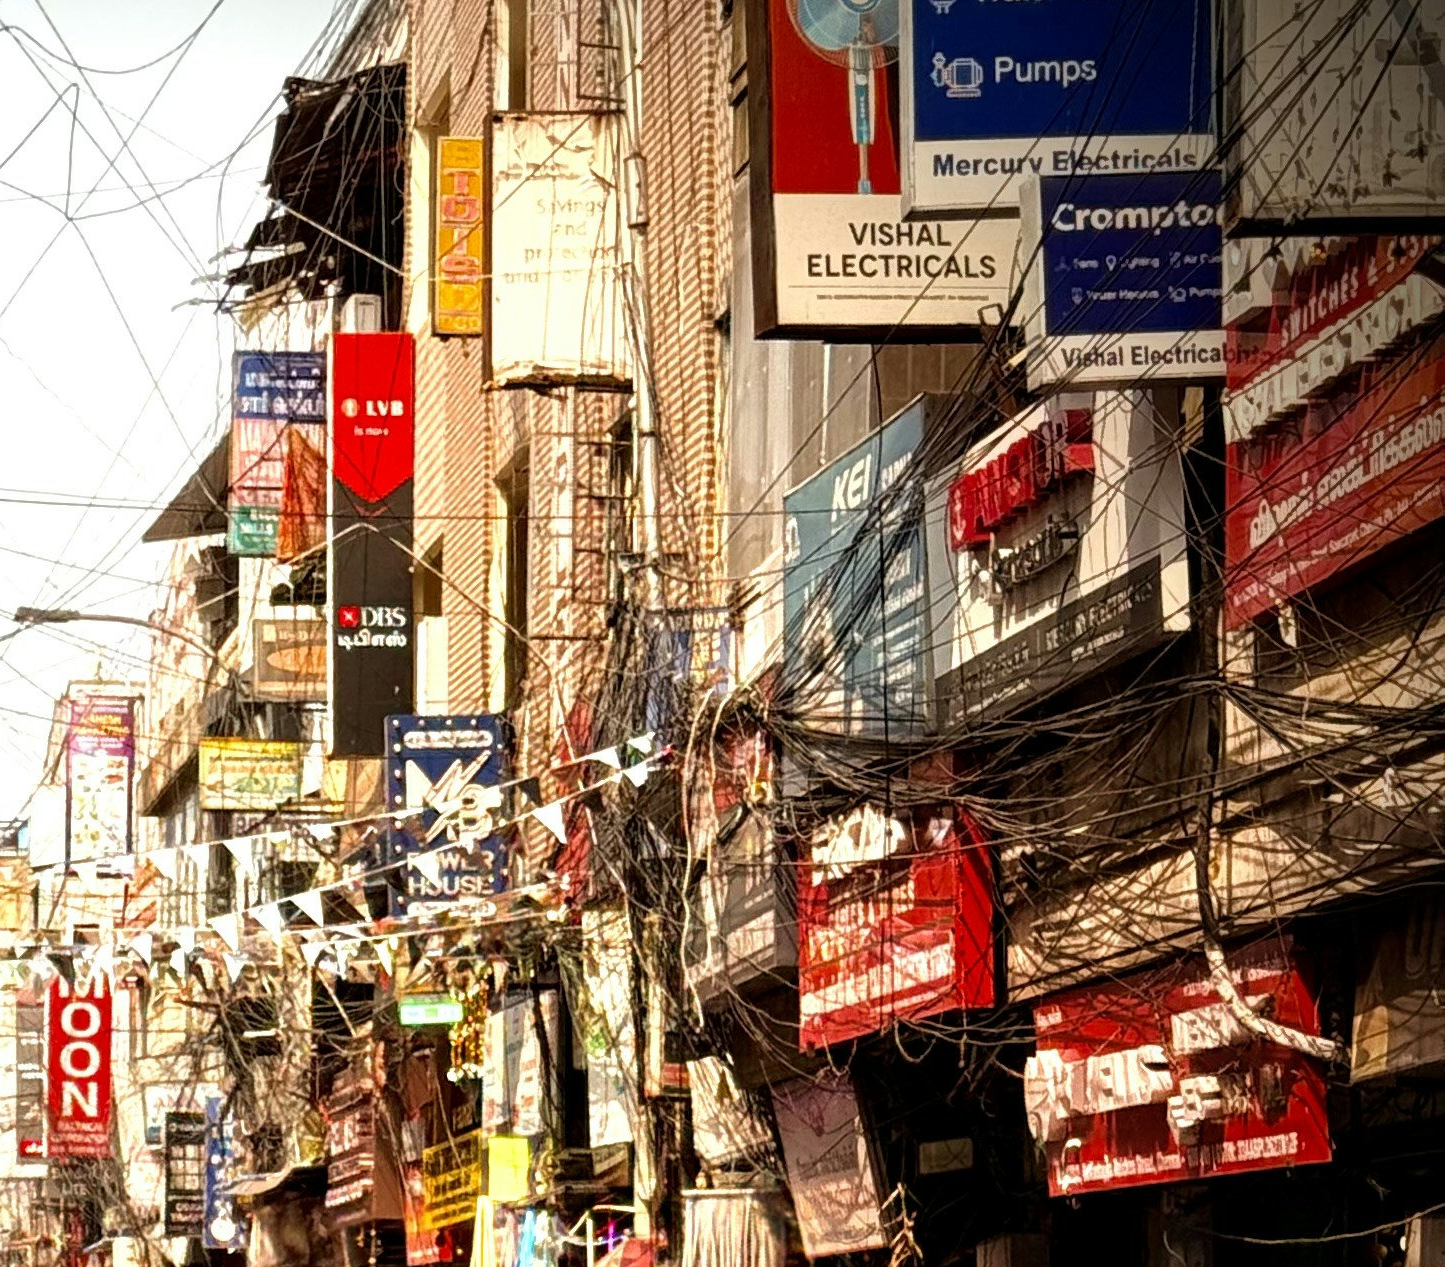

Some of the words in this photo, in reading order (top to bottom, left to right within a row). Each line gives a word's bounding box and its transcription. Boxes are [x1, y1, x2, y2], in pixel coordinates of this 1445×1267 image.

[994, 56, 1097, 88] Pumps
[933, 152, 1042, 177] Mercury
[1052, 148, 1197, 172] Electricals
[1052, 200, 1222, 235] Crompto
[848, 222, 953, 248] VISHAL
[807, 254, 996, 280] ELECTRICALS
[1062, 343, 1124, 368] Vishal
[366, 400, 405, 416] LVB
[830, 453, 872, 523] KEI
[360, 606, 406, 628] DBS
[59, 966, 102, 1118] MOON
